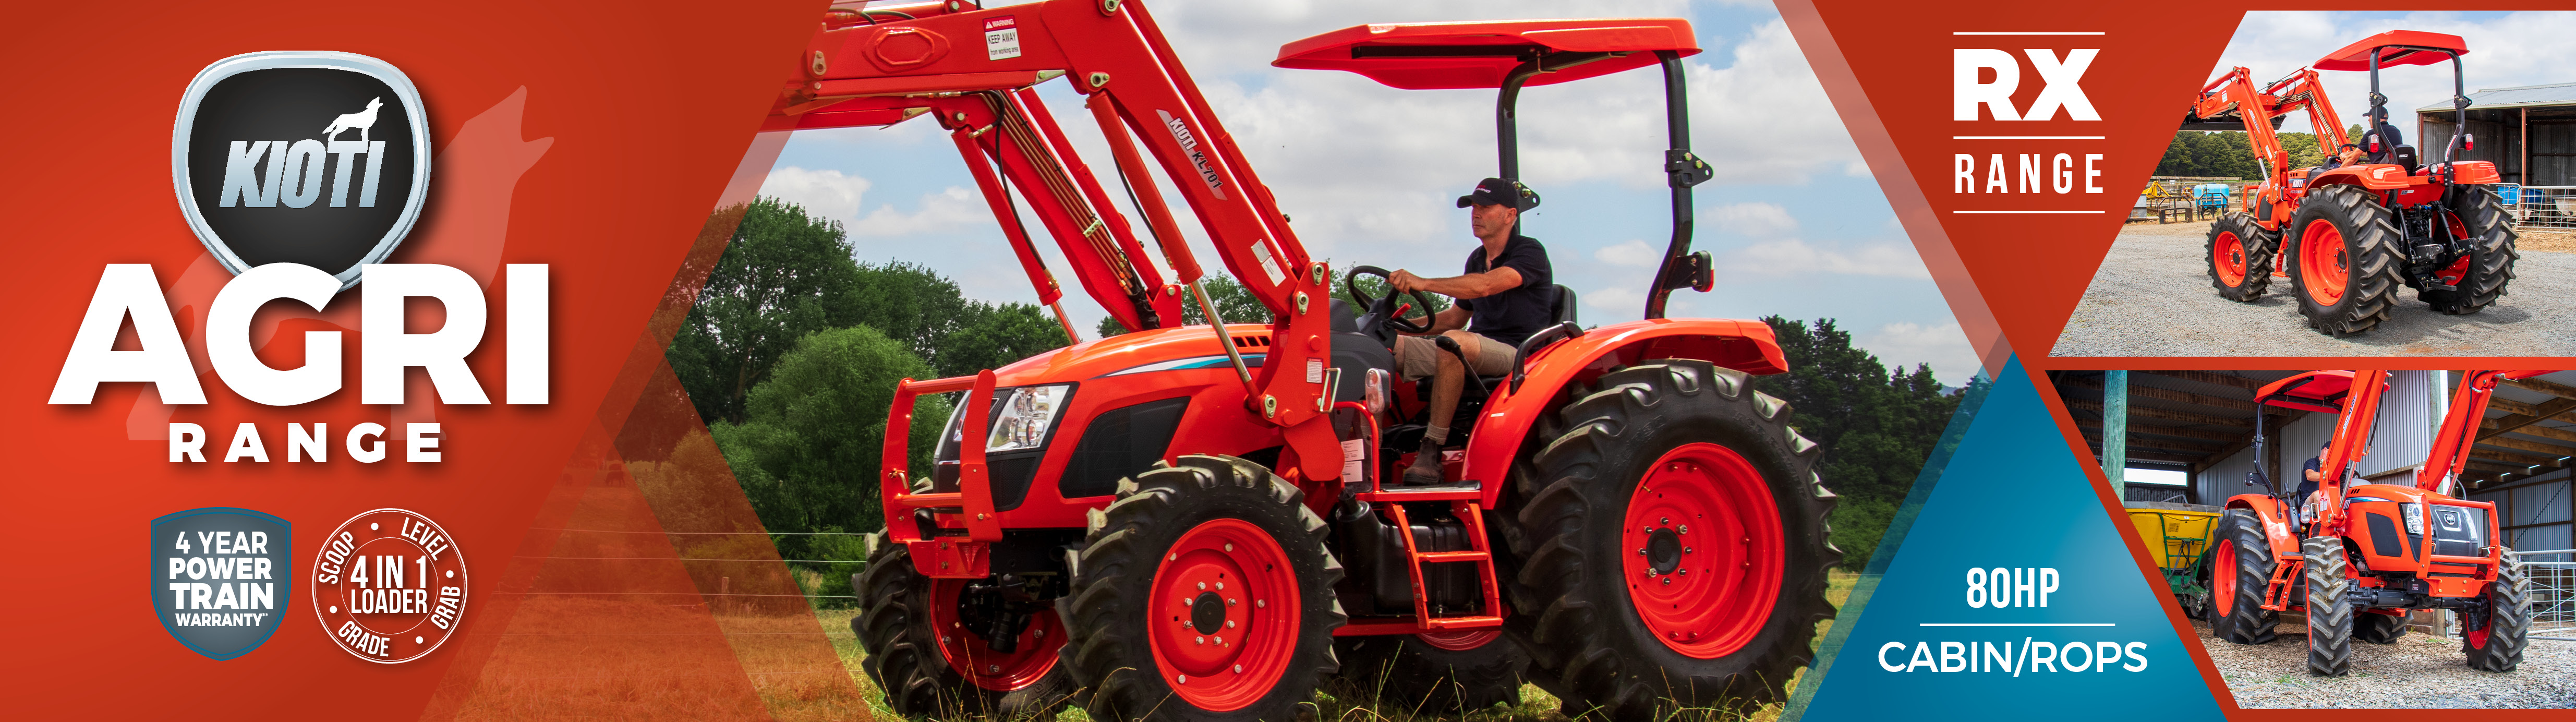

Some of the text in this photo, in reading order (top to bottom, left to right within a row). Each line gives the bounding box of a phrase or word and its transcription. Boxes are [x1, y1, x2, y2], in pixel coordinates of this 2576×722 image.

[988, 32, 1016, 44] KEEP AWAY
[1168, 117, 1198, 151] KIOTI
